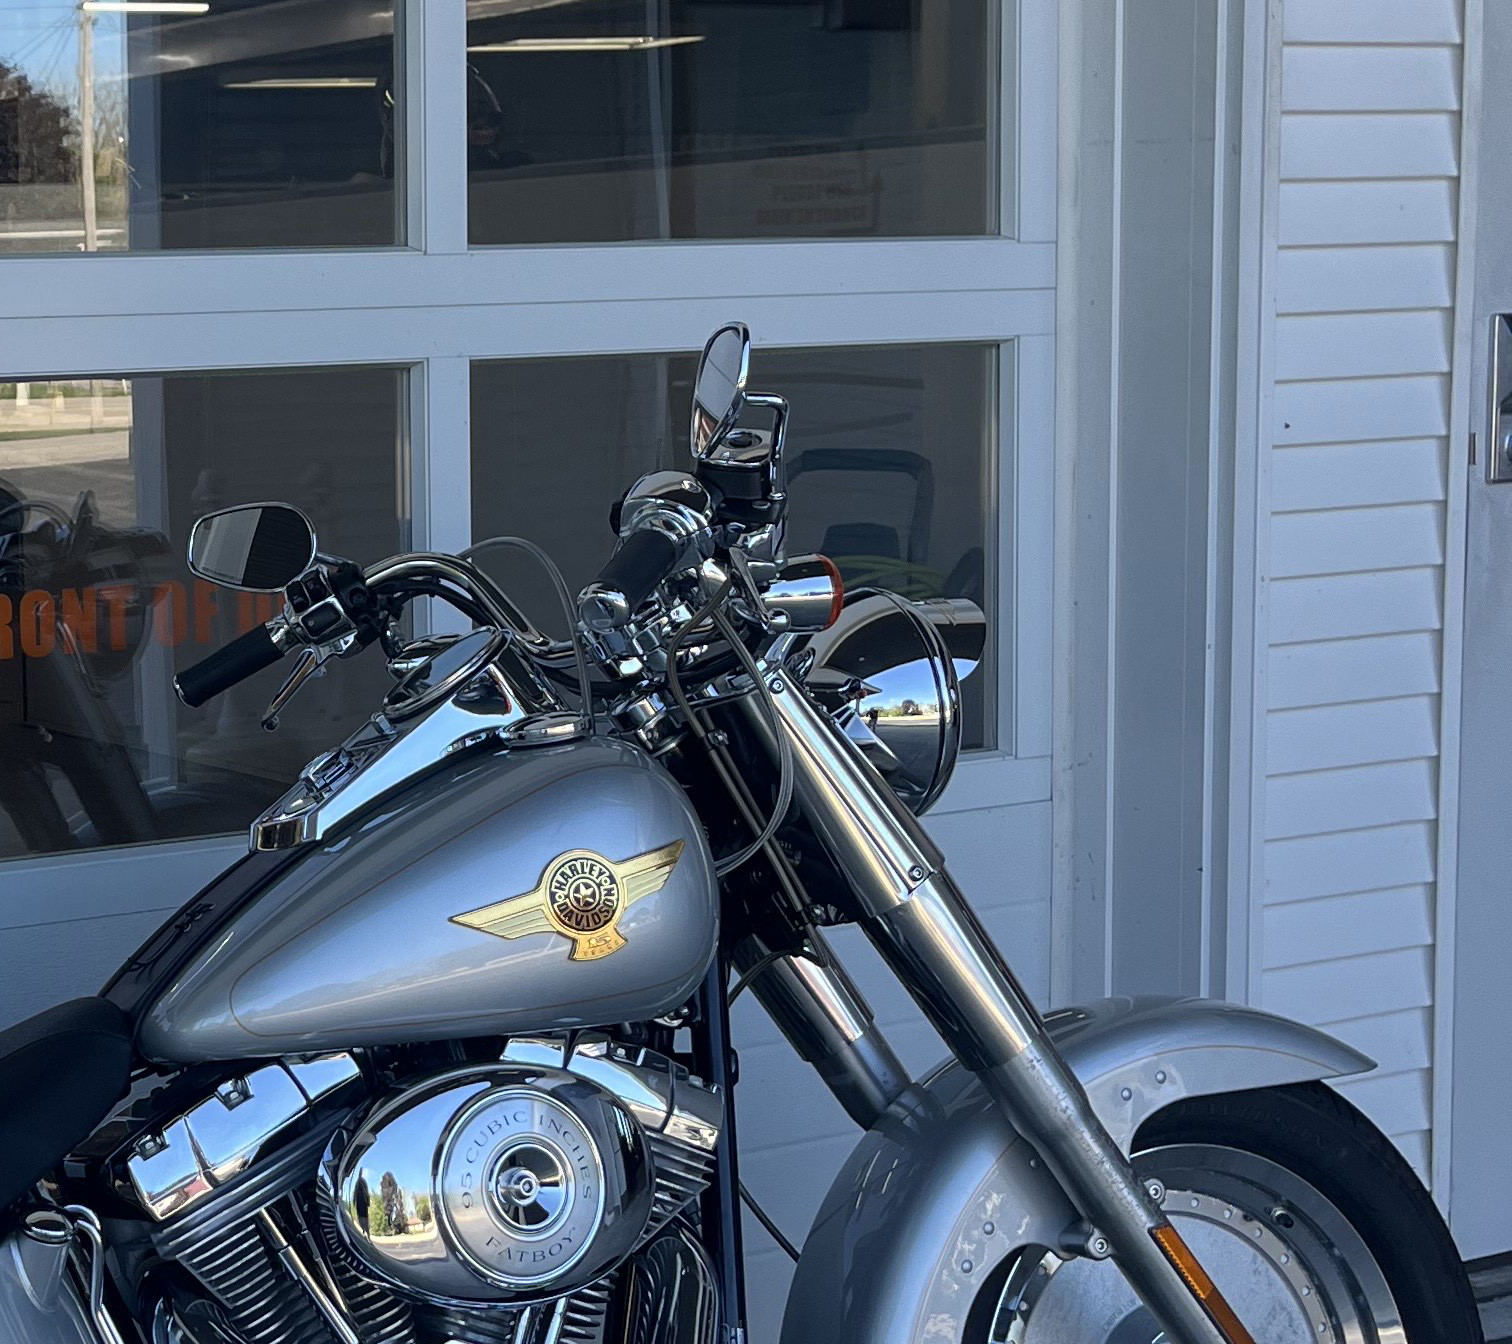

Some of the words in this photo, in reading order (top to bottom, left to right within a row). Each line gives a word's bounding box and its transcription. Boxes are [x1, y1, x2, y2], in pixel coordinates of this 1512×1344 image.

[152, 579, 219, 647] OF
[553, 860, 608, 891] HARLEY
[555, 886, 616, 928] DAVIDSON
[466, 1111, 528, 1163] CUBIC
[539, 1115, 592, 1198] INCHES
[461, 1172, 473, 1208] 95
